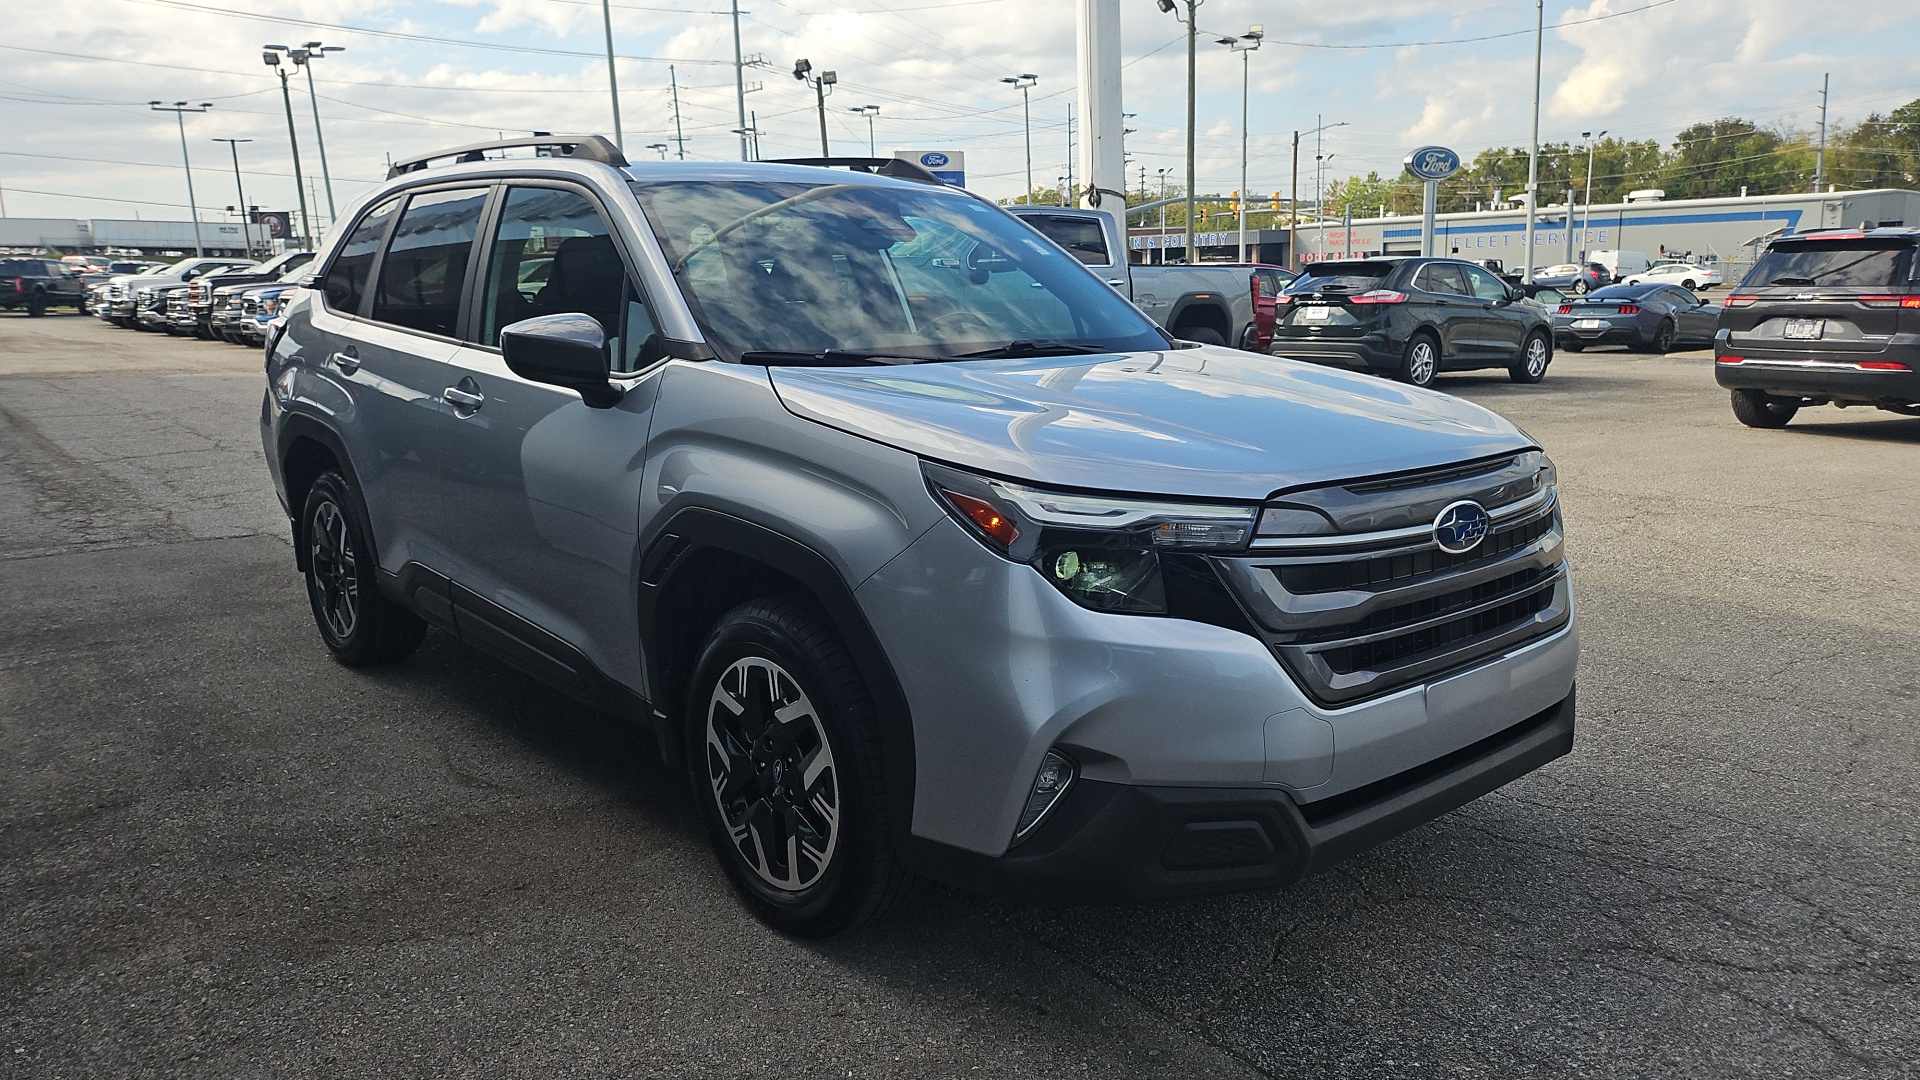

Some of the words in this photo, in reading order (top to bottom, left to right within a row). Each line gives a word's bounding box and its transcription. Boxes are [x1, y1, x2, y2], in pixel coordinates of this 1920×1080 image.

[927, 155, 945, 165] Ford
[1422, 152, 1453, 172] Ford
[1147, 237, 1155, 248] &
[1453, 235, 1510, 249] FLEET
[1299, 253, 1328, 262] BODY
